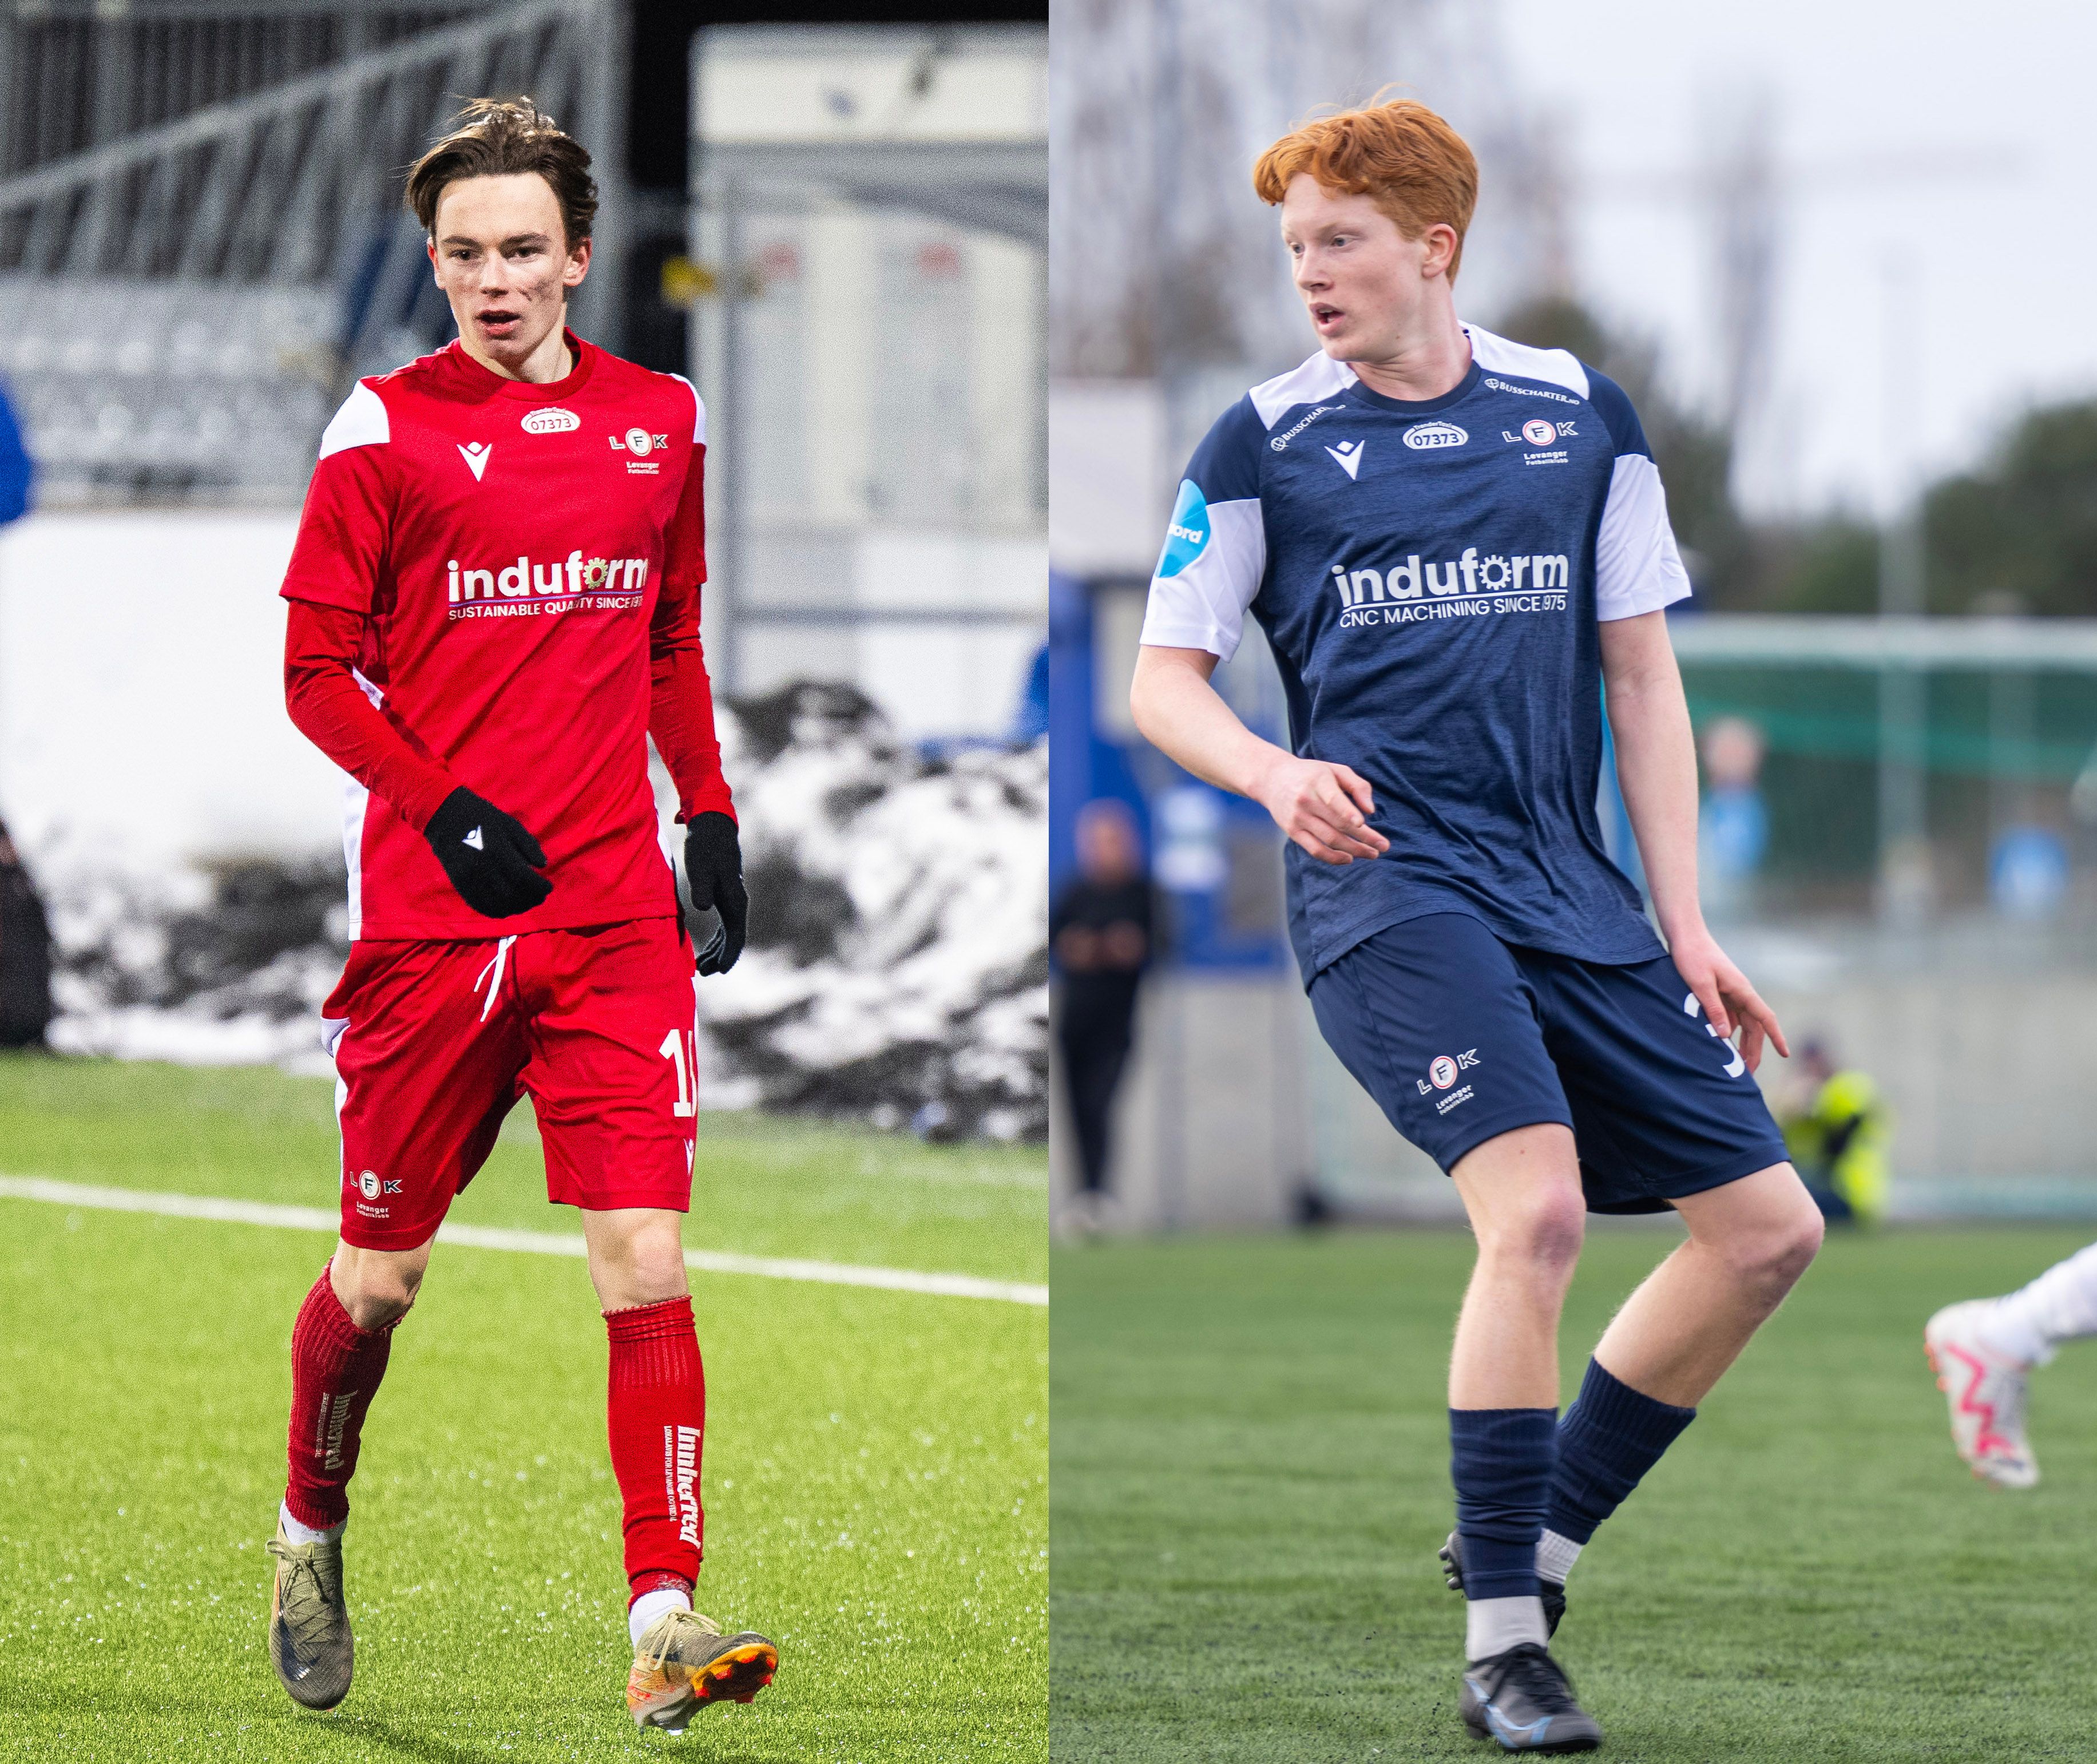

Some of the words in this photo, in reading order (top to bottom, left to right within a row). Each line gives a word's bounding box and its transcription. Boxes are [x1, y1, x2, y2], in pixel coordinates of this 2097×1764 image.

[531, 418, 571, 430] 07373
[1413, 433, 1459, 446] 07373
[1524, 451, 1567, 461] Levanger
[626, 461, 660, 470] Levanger
[1331, 547, 1569, 607] induform
[449, 603, 541, 620] SUSTAINABLE
[1339, 610, 1379, 628] CNC
[1384, 600, 1491, 624] MACHINING
[1493, 596, 1541, 614] SINCE
[1436, 1085, 1471, 1109] Levanger
[356, 1201, 389, 1214] Levanger
[676, 1425, 702, 1549] Innherred
